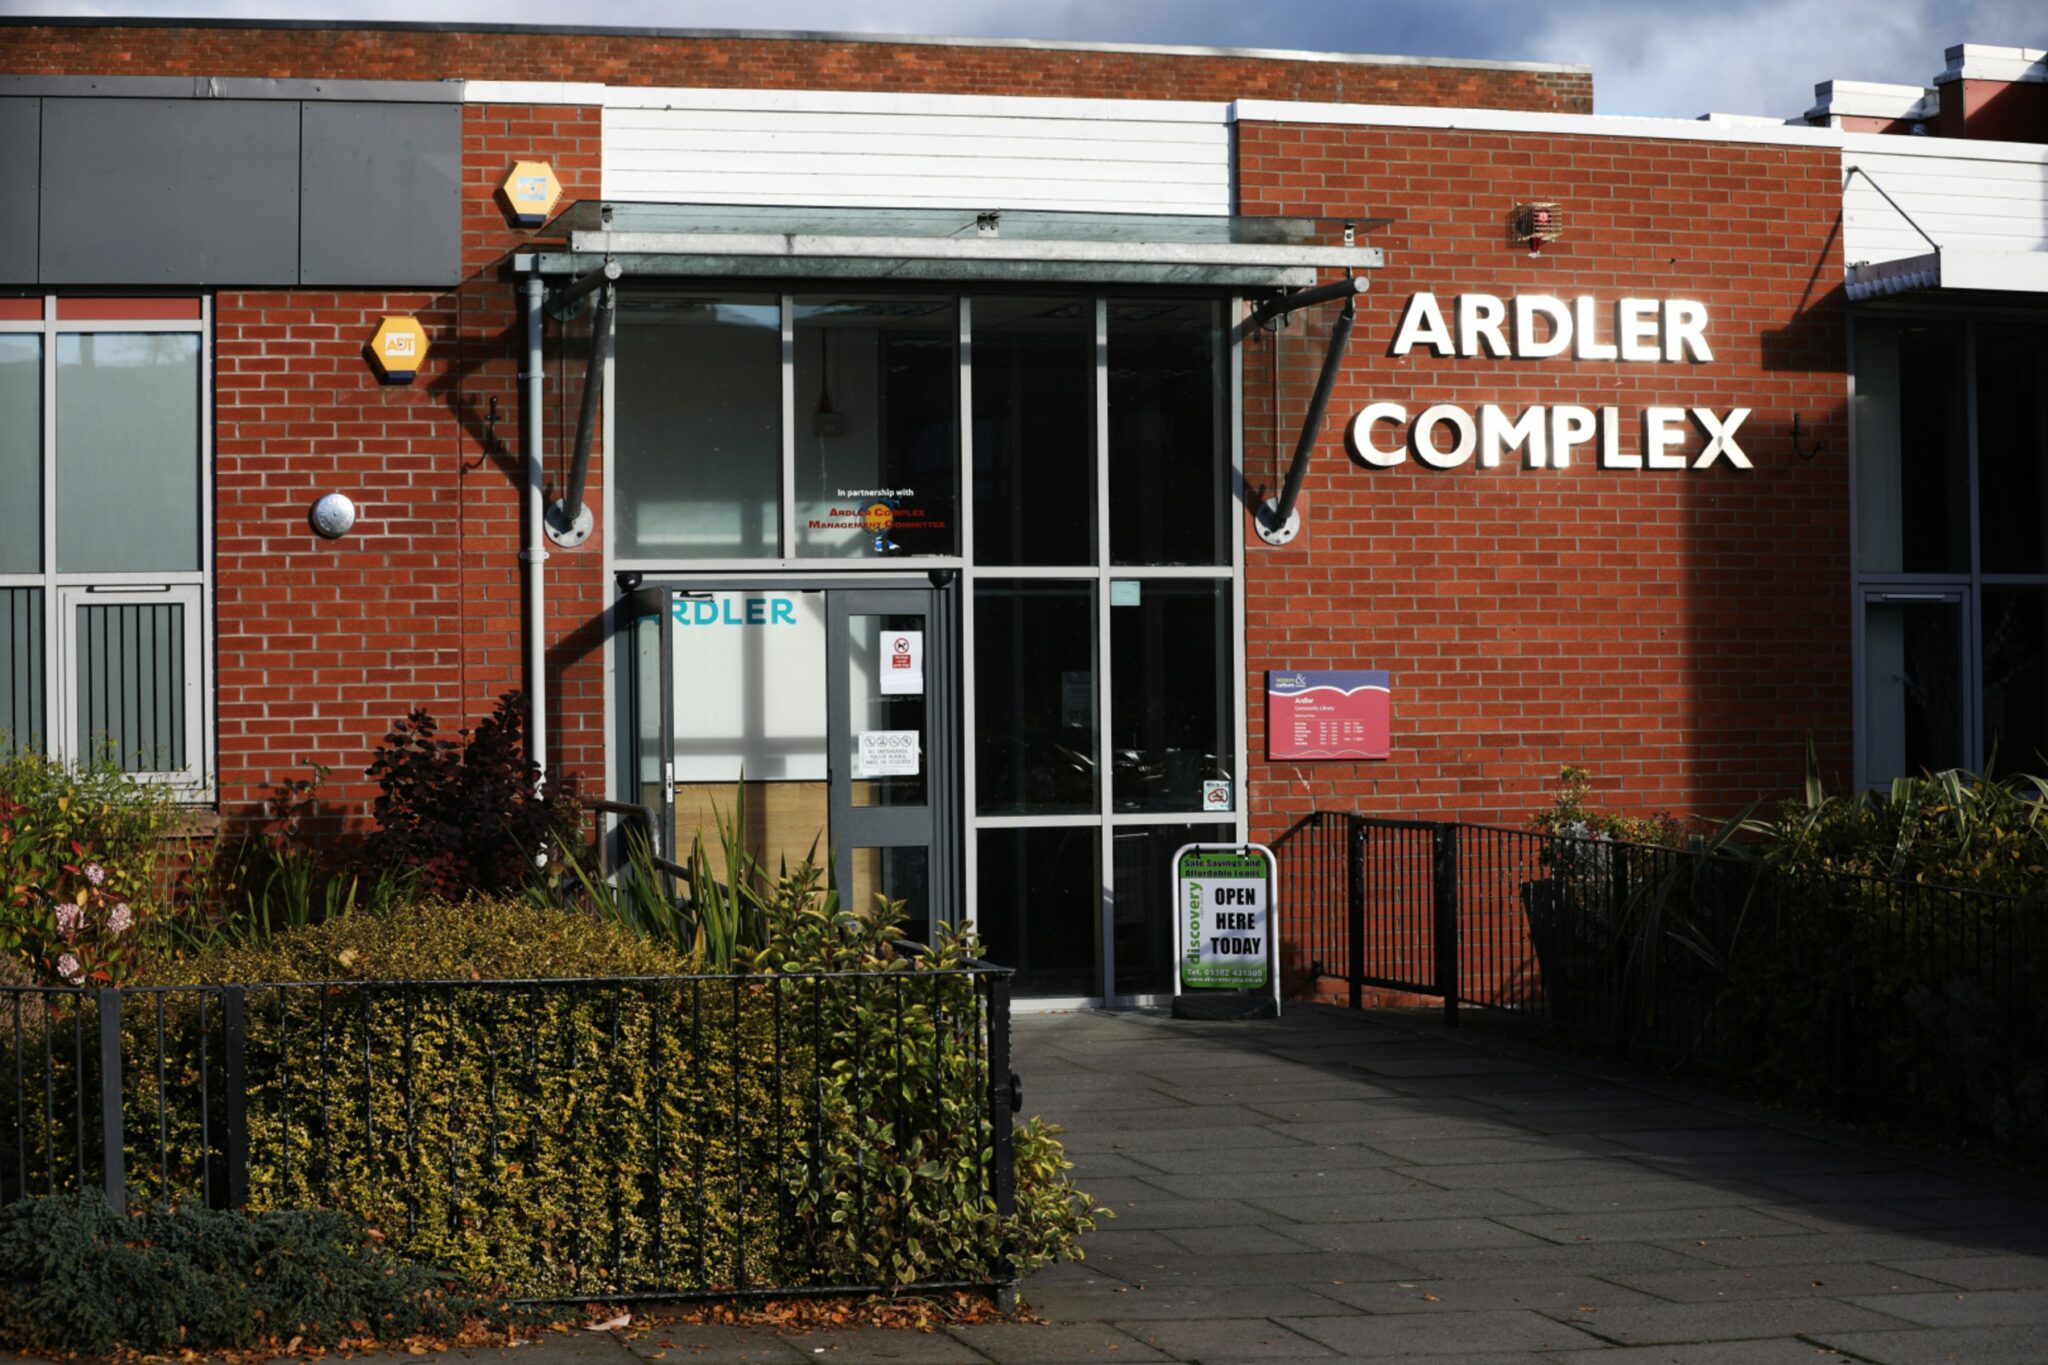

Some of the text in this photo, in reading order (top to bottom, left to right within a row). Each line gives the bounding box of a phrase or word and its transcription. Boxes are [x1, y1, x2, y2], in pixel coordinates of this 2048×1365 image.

[1393, 292, 1714, 362] ARDLER
[386, 337, 414, 352] ADT
[1352, 402, 1755, 469] COMPLEX
[837, 488, 915, 498] In partnership with
[1184, 859, 1262, 869] Safe Savings and
[1185, 870, 1260, 878] Affordable Loans
[1215, 888, 1255, 905] OPEN
[1187, 882, 1204, 966] discovery
[1216, 912, 1255, 930] HERE
[1210, 937, 1261, 955] TODAY
[1187, 968, 1201, 976] Tel.
[1204, 968, 1229, 976] 01382
